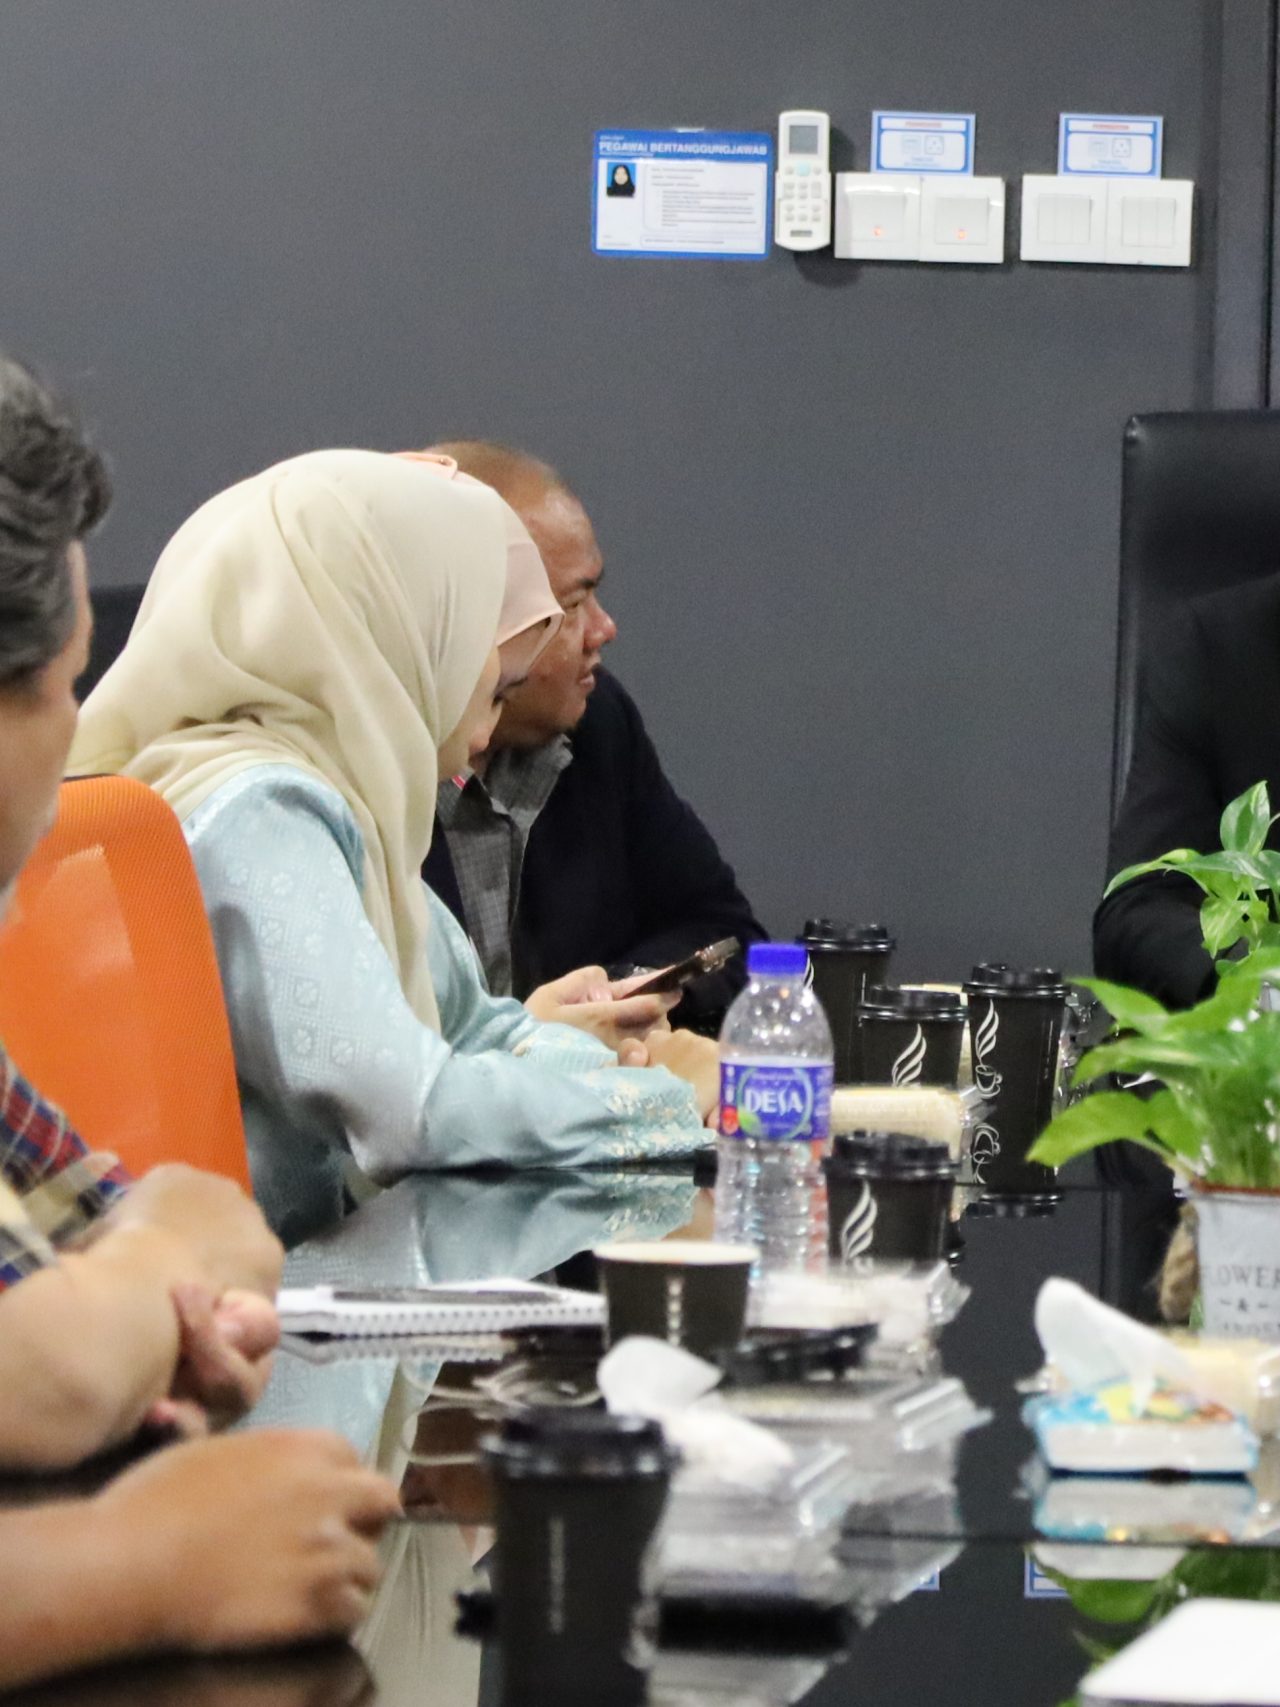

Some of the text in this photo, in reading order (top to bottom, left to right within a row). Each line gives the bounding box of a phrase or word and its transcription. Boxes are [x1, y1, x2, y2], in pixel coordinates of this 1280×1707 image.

[599, 141, 648, 152] PEGAWAI
[650, 142, 768, 155] BERTANGGUNGJAWAB
[744, 1087, 804, 1116] DESA
